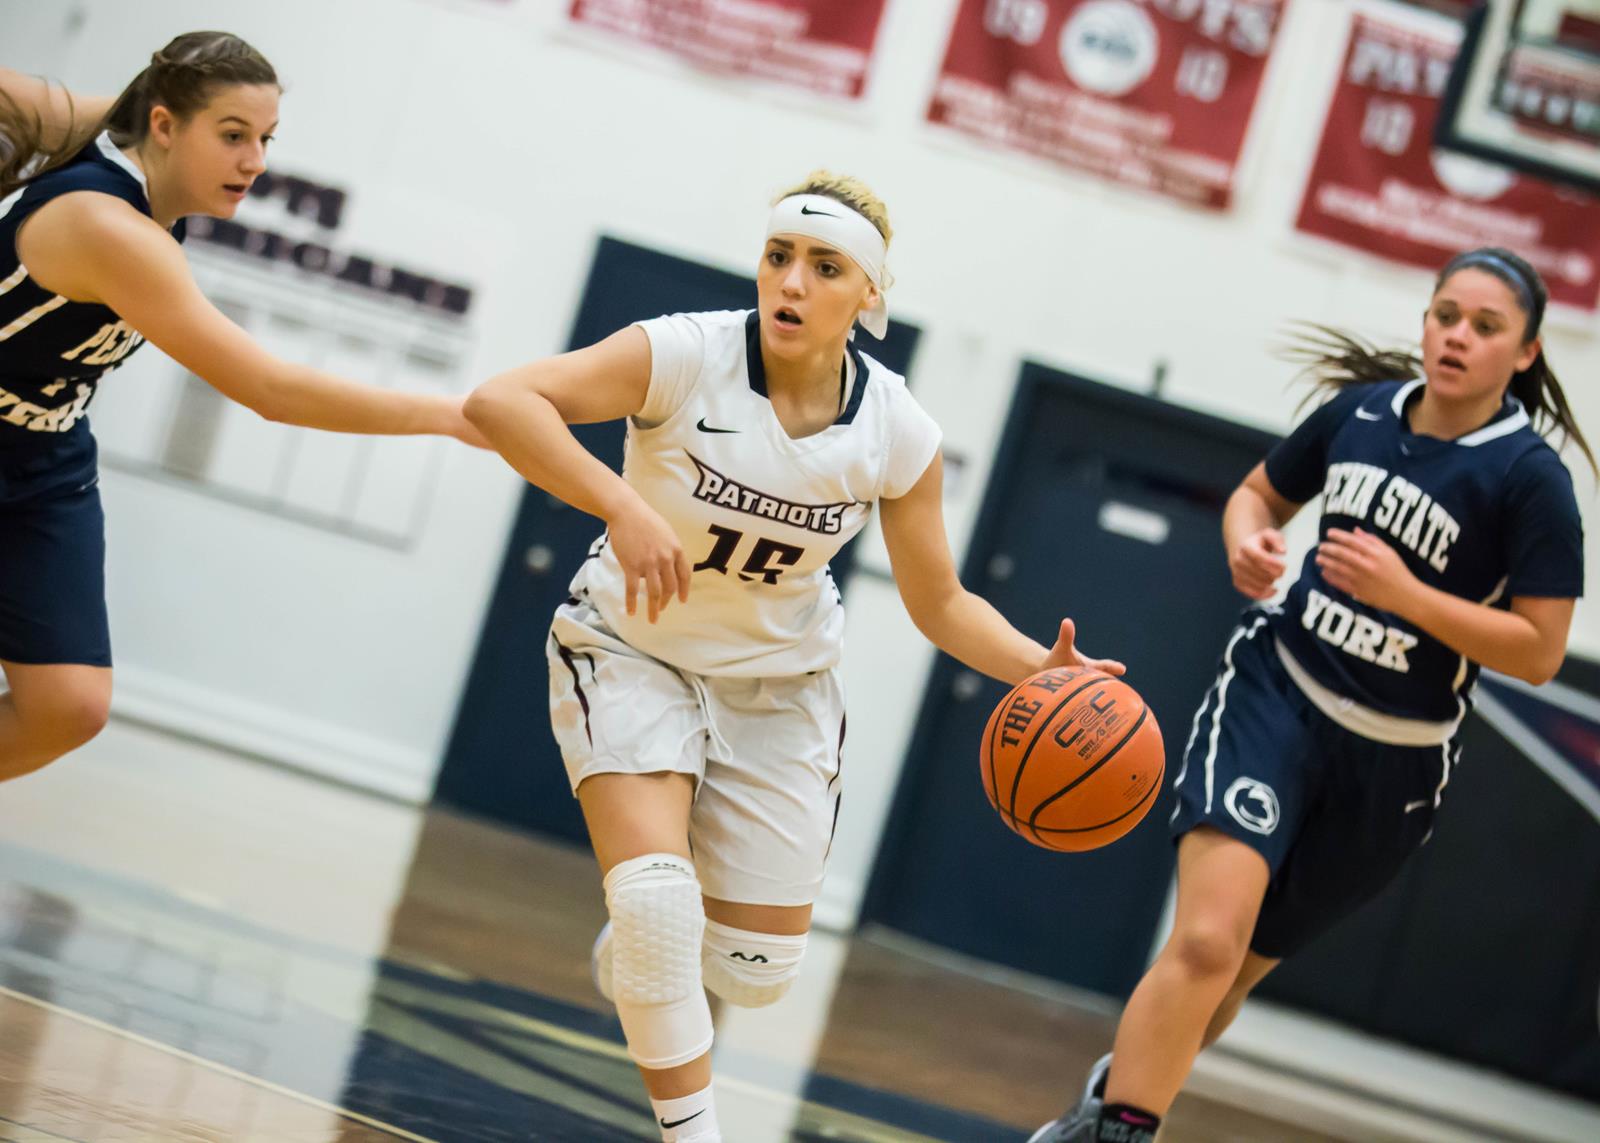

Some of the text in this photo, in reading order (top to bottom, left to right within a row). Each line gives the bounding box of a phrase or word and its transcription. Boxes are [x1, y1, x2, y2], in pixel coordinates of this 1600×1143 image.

[692, 460, 845, 535] PATRIOTS
[1323, 461, 1460, 573] PENN STATE
[693, 523, 805, 585] 15
[1301, 588, 1418, 674] YORK
[1001, 696, 1043, 749] THE
